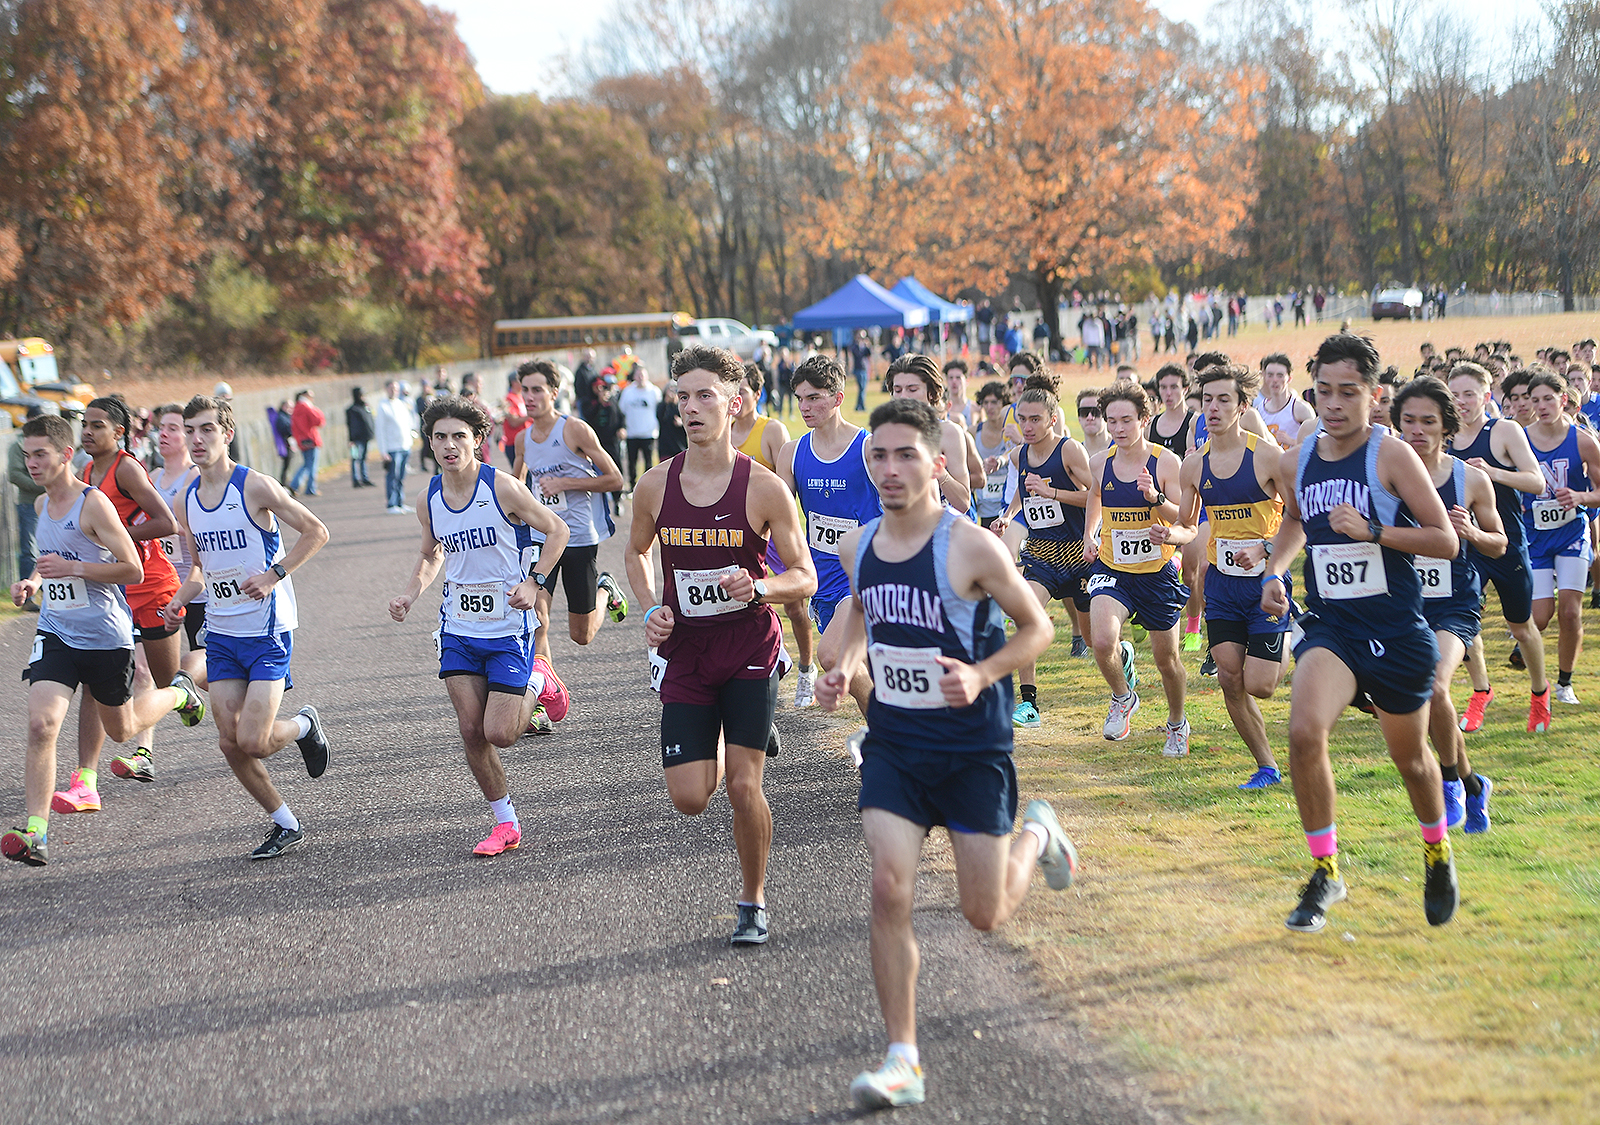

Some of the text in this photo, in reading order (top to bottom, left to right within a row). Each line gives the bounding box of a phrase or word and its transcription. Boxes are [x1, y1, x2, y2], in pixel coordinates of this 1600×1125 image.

[807, 478, 846, 488] LEWIS S MILLS
[1028, 505, 1055, 522] 815
[1110, 510, 1151, 522] WESTON
[1541, 507, 1567, 523] 807
[660, 526, 744, 548] SHEEHAN
[1120, 538, 1152, 556] 878
[709, 569, 731, 577] Country
[1326, 560, 1369, 586] 887
[48, 583, 76, 601] 831
[212, 579, 242, 600] 861
[687, 584, 732, 606] 840
[460, 593, 494, 613] 859
[884, 665, 929, 693] 885
